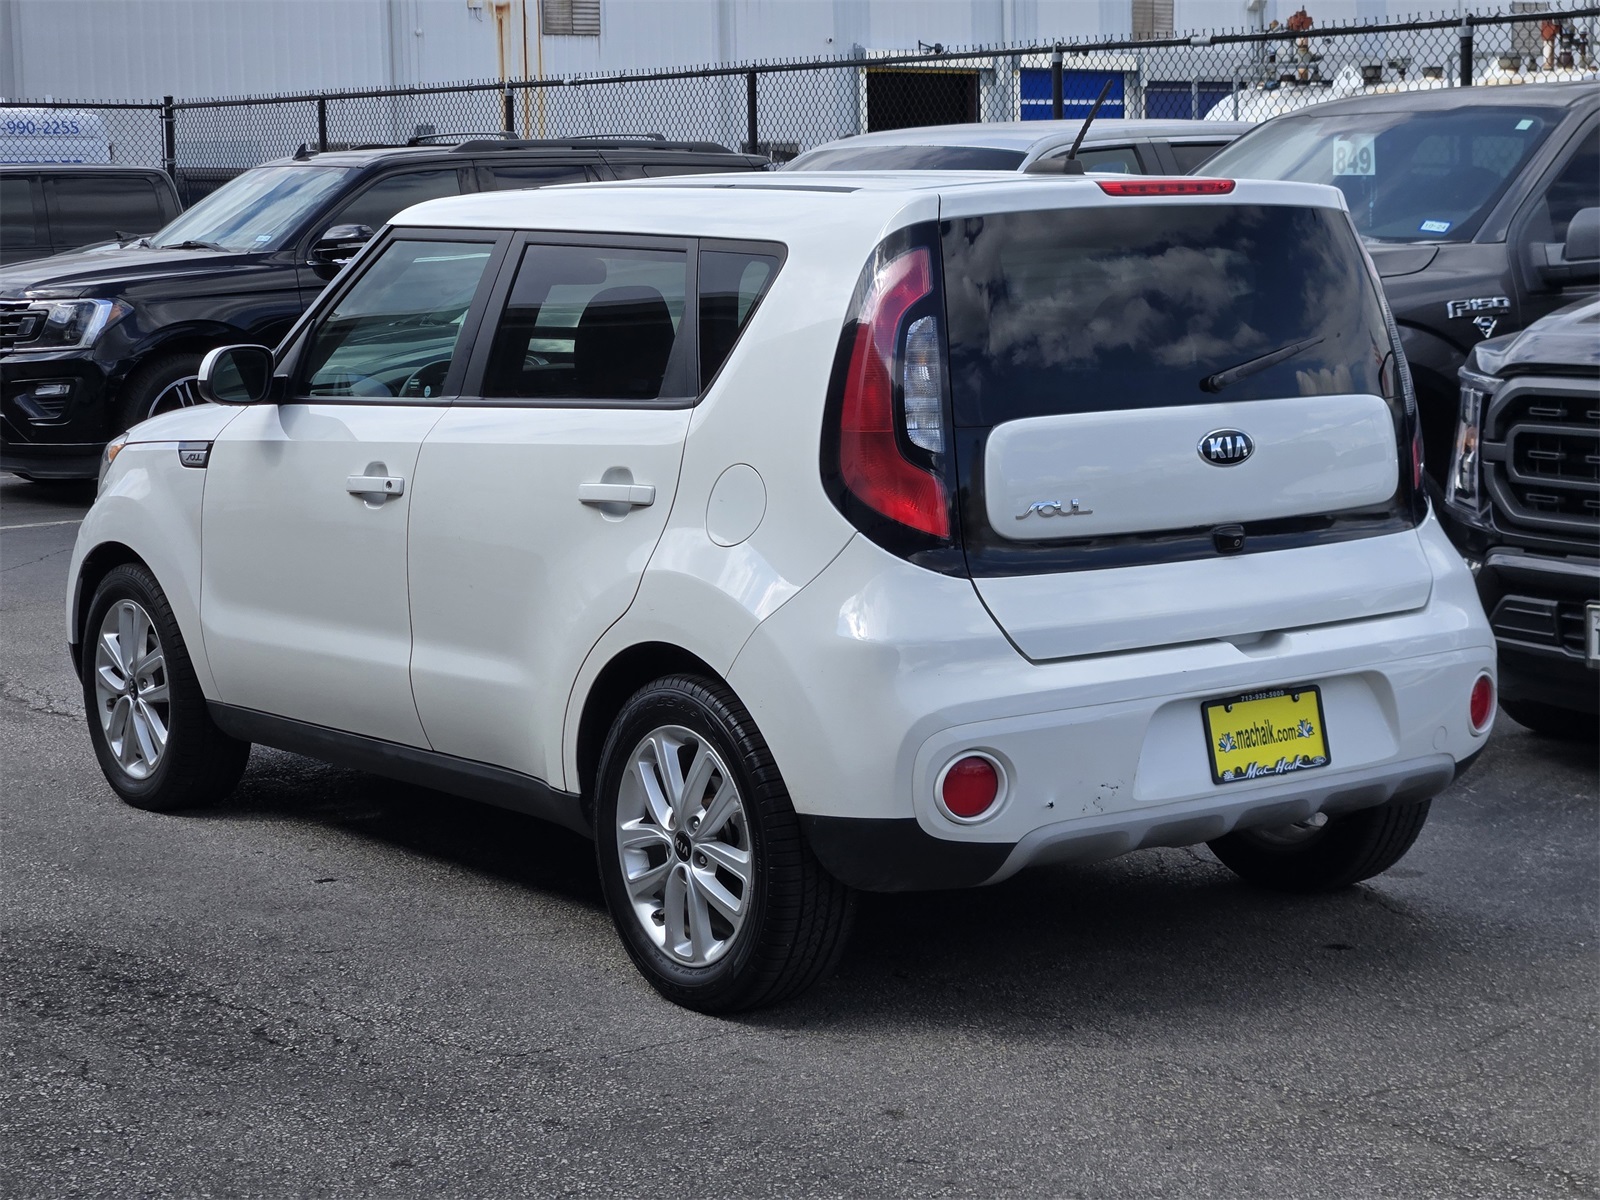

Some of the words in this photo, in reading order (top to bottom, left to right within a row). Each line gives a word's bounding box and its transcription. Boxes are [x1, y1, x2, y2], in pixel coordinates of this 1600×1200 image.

[1335, 146, 1372, 175] 849
[1208, 436, 1248, 460] KIA
[1015, 498, 1094, 521] SOUL
[1235, 719, 1298, 750] machaik.com
[1245, 761, 1274, 779] Mac
[675, 837, 689, 857] KIA
